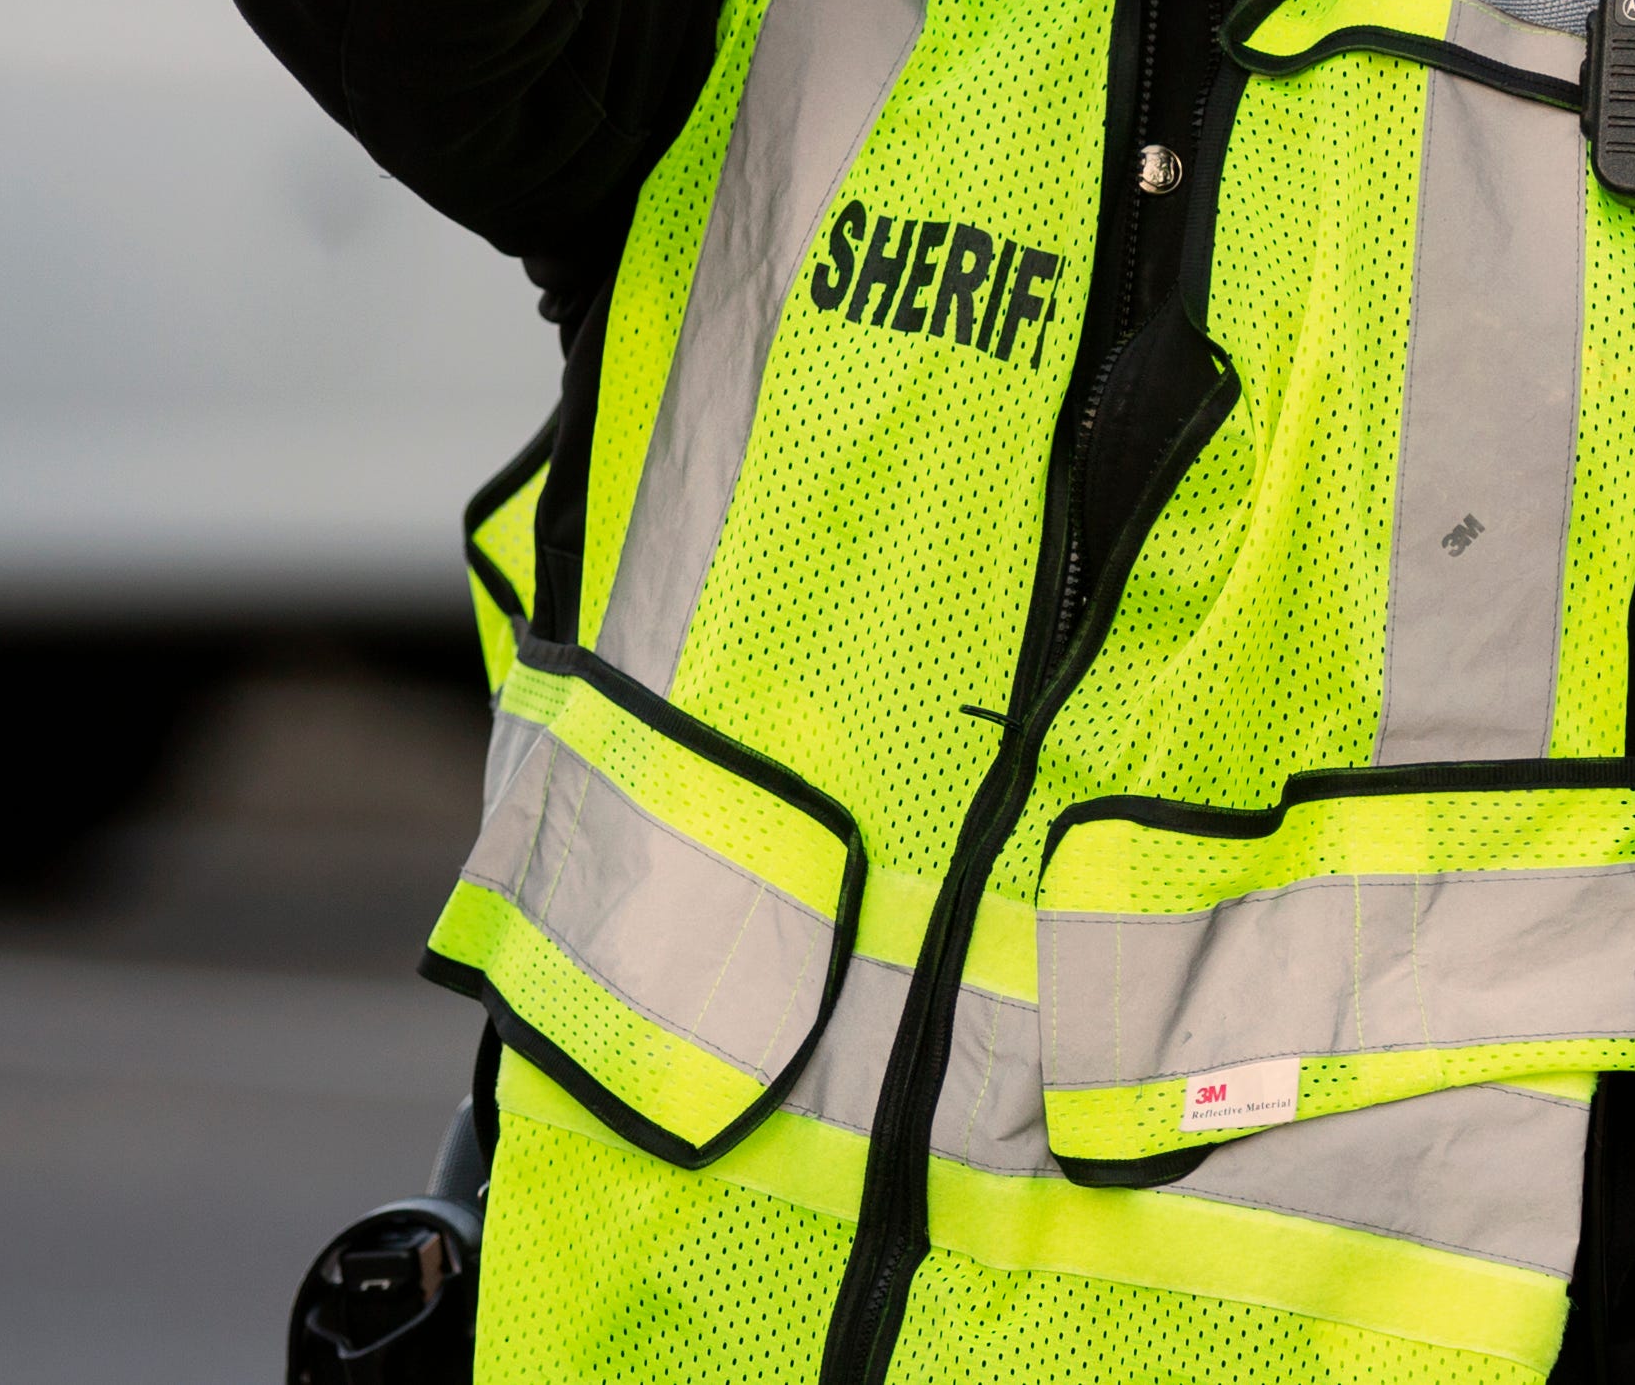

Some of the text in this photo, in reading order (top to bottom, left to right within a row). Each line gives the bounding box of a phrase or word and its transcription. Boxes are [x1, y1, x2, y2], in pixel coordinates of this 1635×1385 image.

[1442, 513, 1485, 557] 3M
[1195, 1084, 1227, 1105] 3M
[1192, 1098, 1292, 1119] Reflective Material
